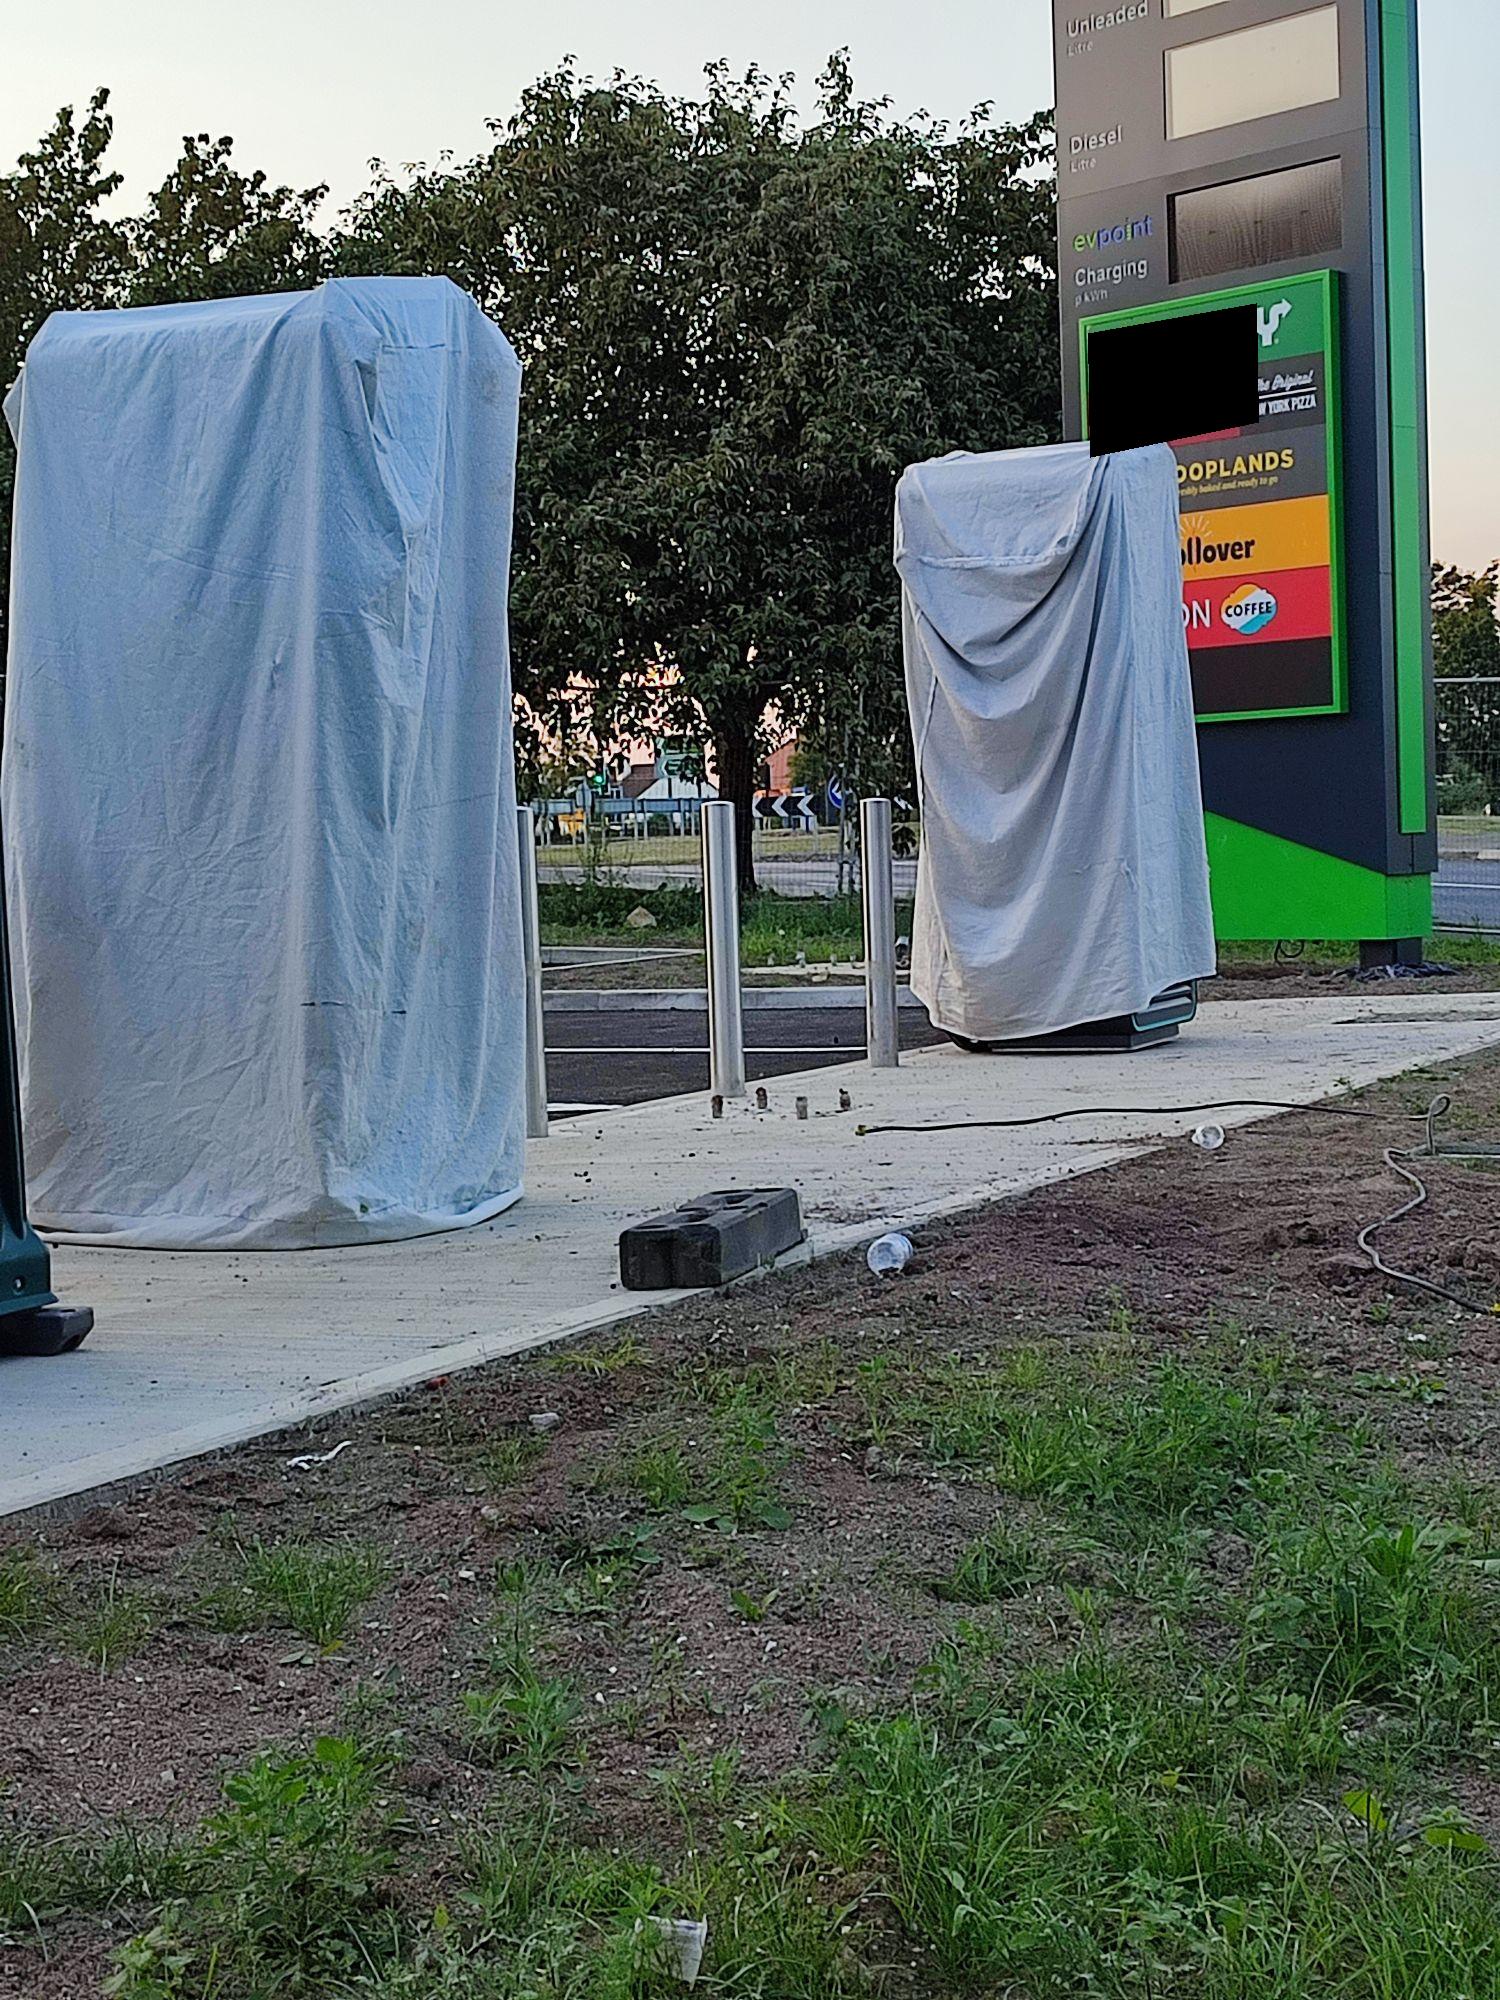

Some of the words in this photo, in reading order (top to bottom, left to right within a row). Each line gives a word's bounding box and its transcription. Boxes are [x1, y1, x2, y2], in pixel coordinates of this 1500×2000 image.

[1067, 0, 1148, 37] Unleaded
[1070, 124, 1122, 155] Diesel
[1073, 216, 1153, 252] evpoint
[1075, 259, 1148, 287] Charging
[1268, 398, 1291, 414] YORK
[1291, 393, 1317, 411] PIZZA
[1225, 601, 1272, 618] COFFEE
